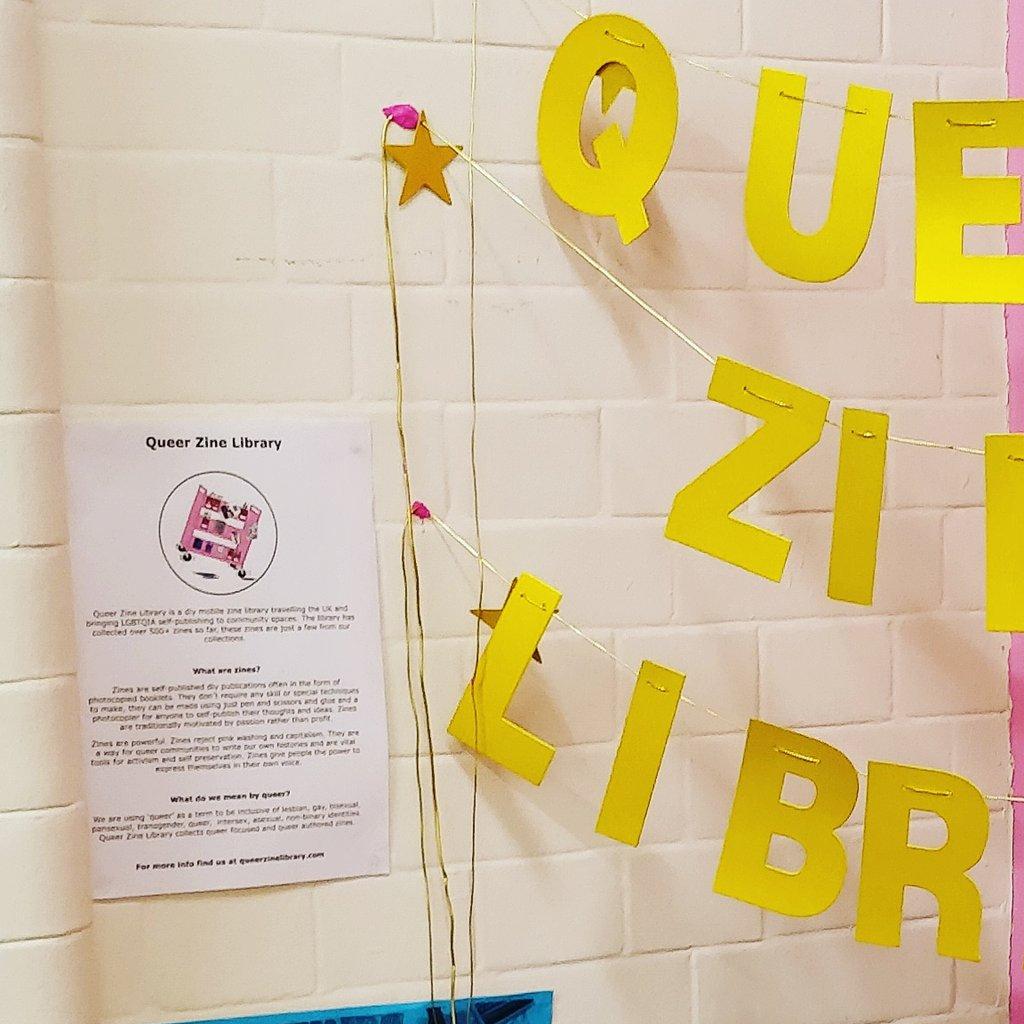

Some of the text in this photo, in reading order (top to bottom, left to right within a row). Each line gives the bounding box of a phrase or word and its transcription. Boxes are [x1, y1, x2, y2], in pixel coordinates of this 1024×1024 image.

[146, 436, 281, 450] Queer Zine Library
